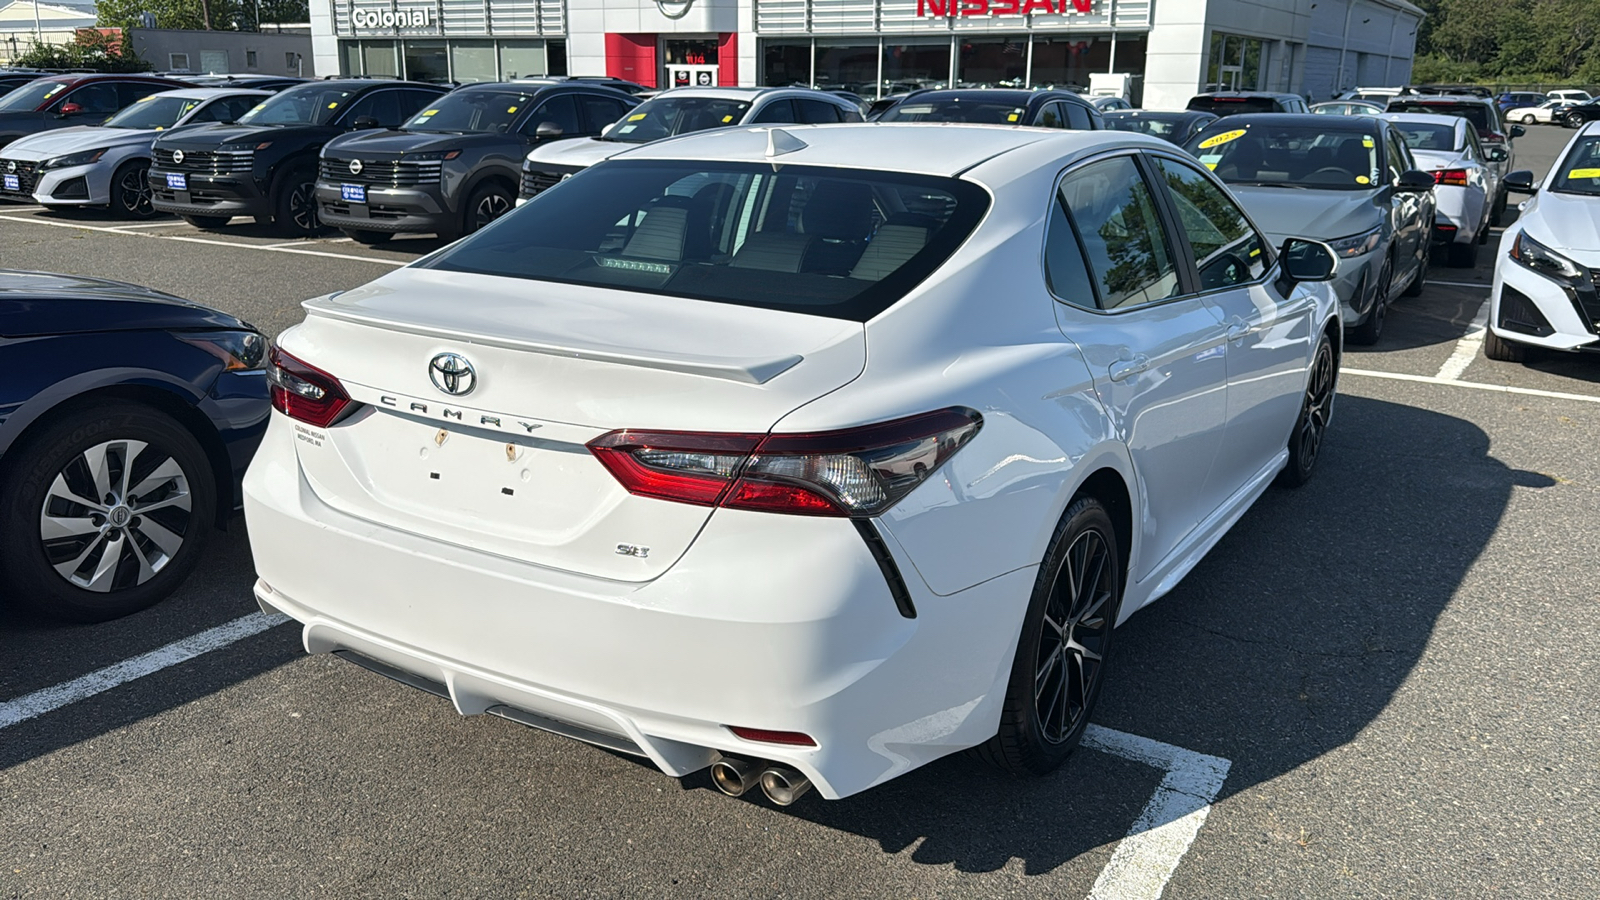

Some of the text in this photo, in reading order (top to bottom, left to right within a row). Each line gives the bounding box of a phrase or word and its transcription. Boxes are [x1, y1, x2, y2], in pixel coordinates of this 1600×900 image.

[917, 0, 1092, 17] NISSAN
[352, 7, 431, 28] Colonial
[1209, 132, 1238, 146] 2025
[380, 395, 544, 433] CAMRY
[311, 431, 325, 441] NISSAN
[614, 544, 650, 559] SE
